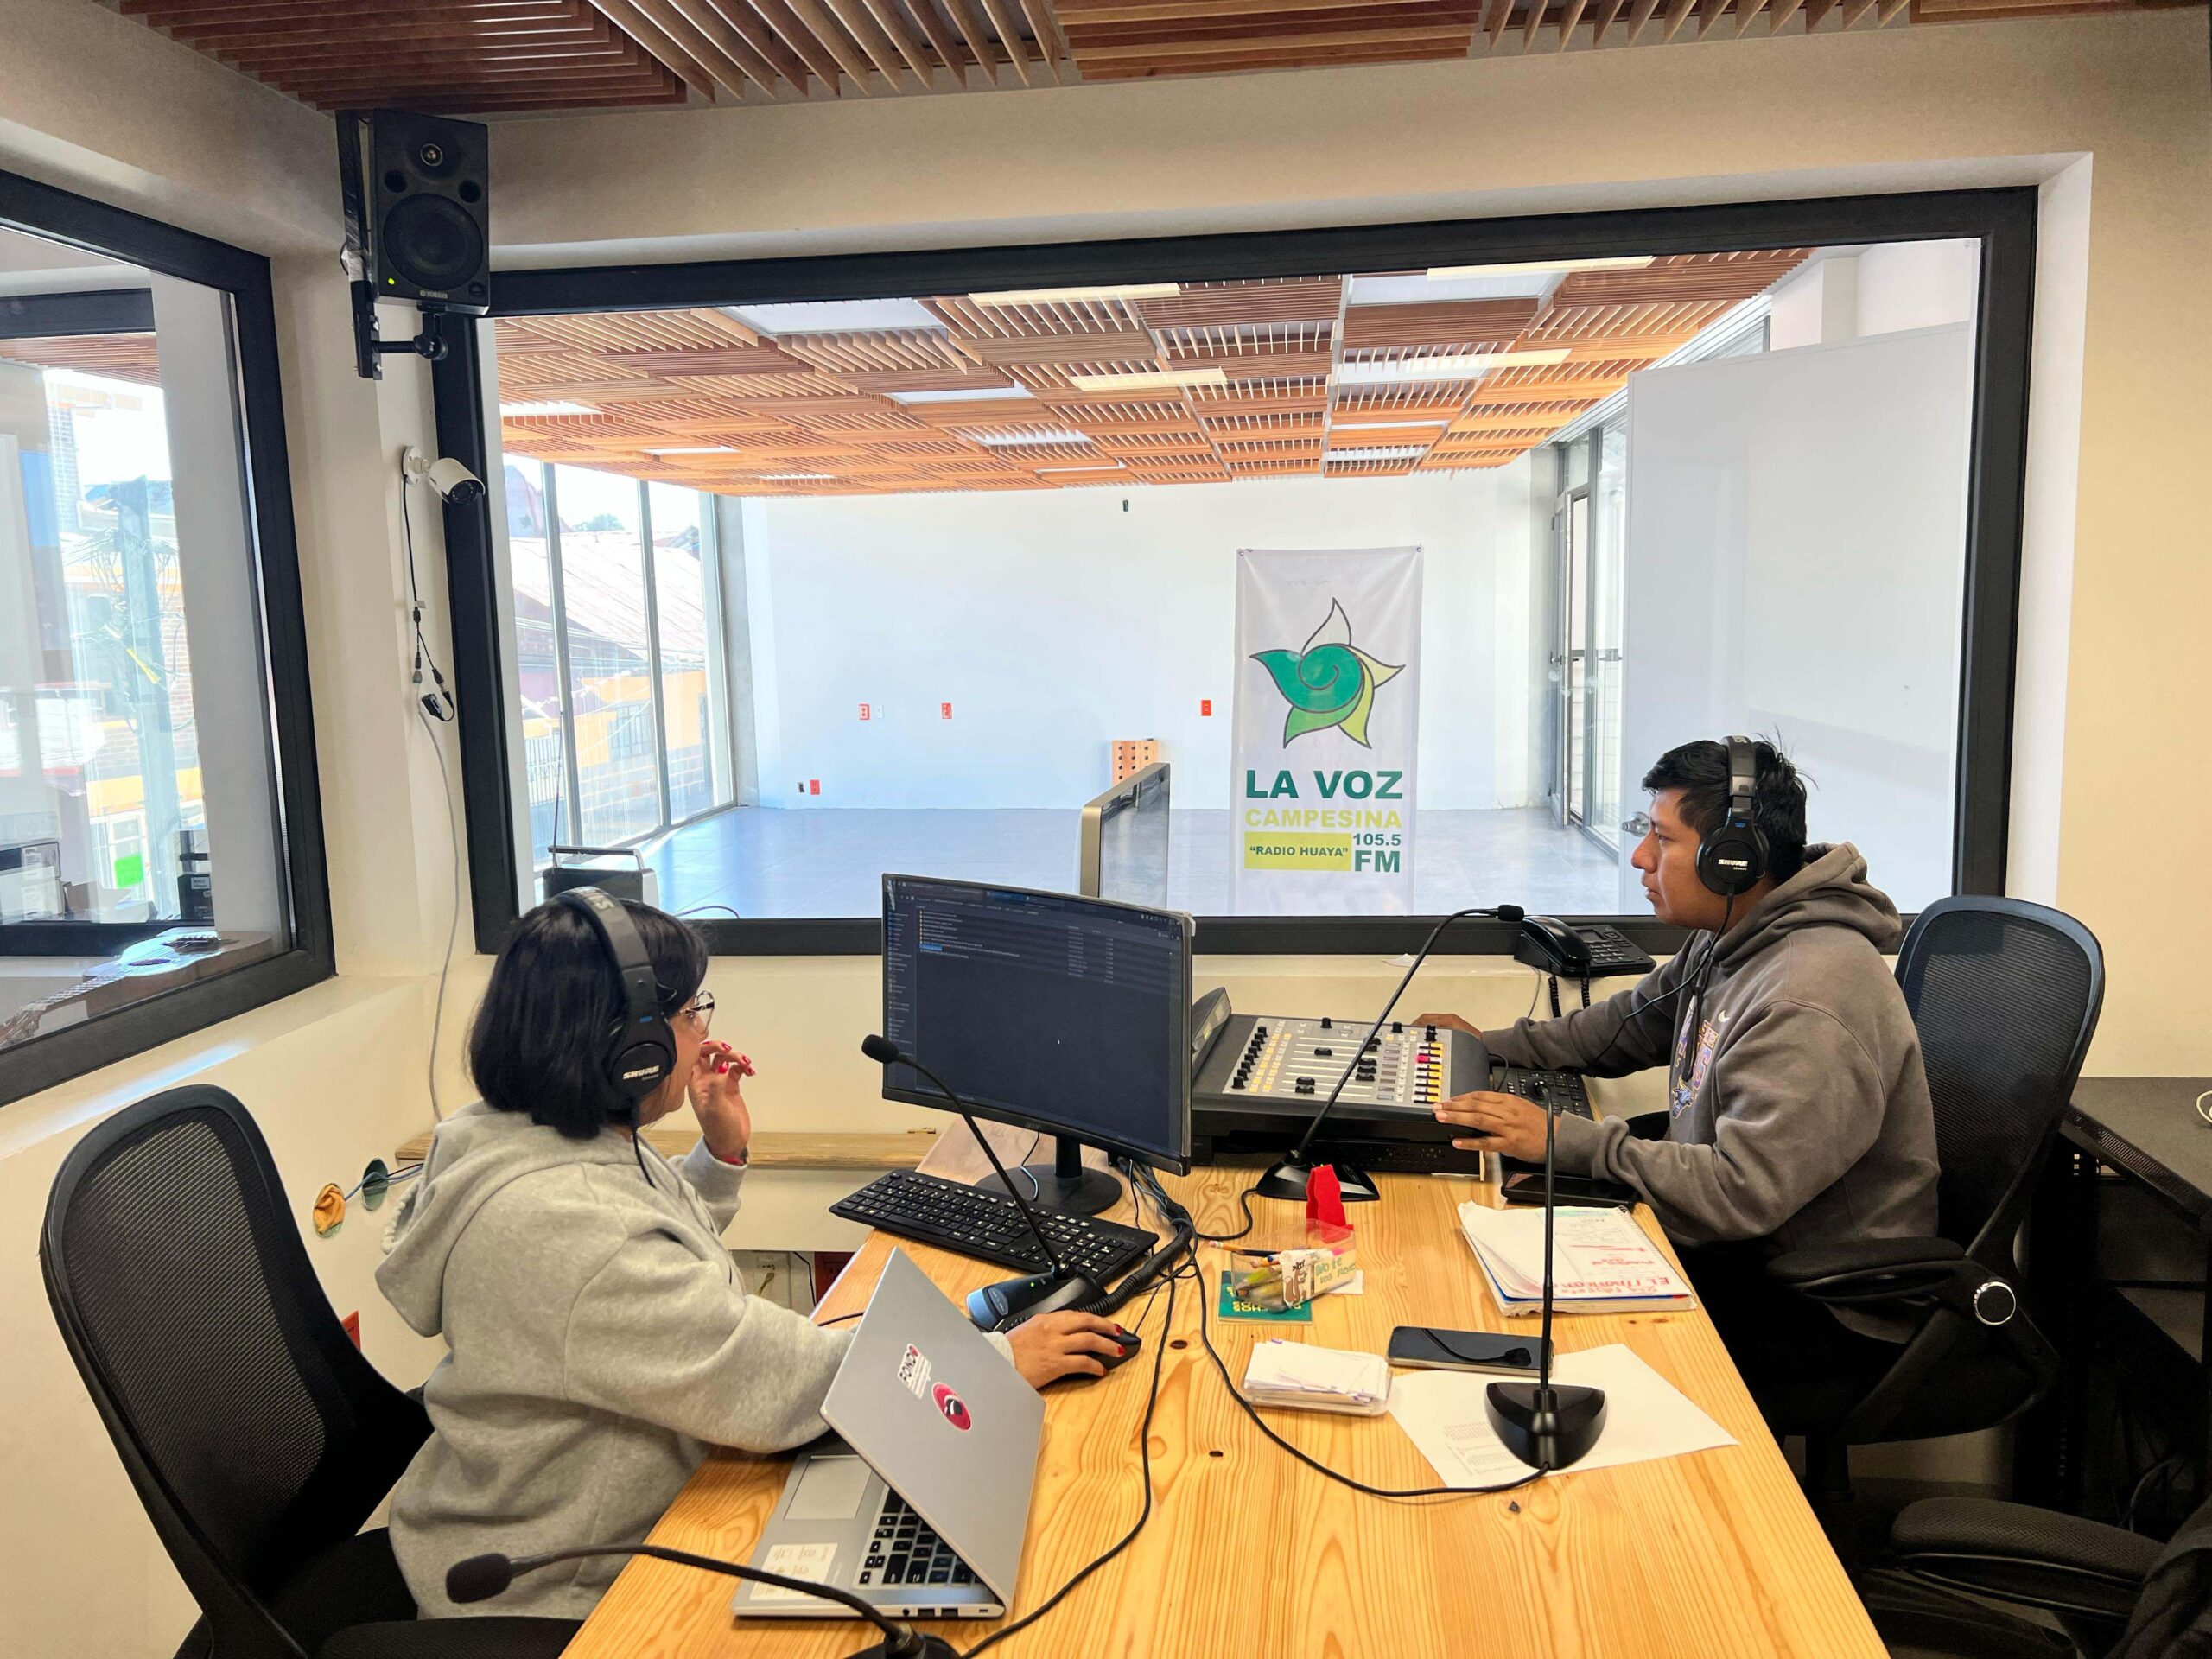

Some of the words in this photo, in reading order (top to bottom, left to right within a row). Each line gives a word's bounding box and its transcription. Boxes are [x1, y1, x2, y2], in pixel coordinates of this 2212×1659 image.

[1246, 770, 1299, 798] LA
[1313, 770, 1402, 799] VOZ
[1244, 808, 1402, 829] CAMPESINA
[1353, 833, 1402, 846] 105.5
[1355, 850, 1400, 873] FM
[622, 1065, 659, 1079] SHURE
